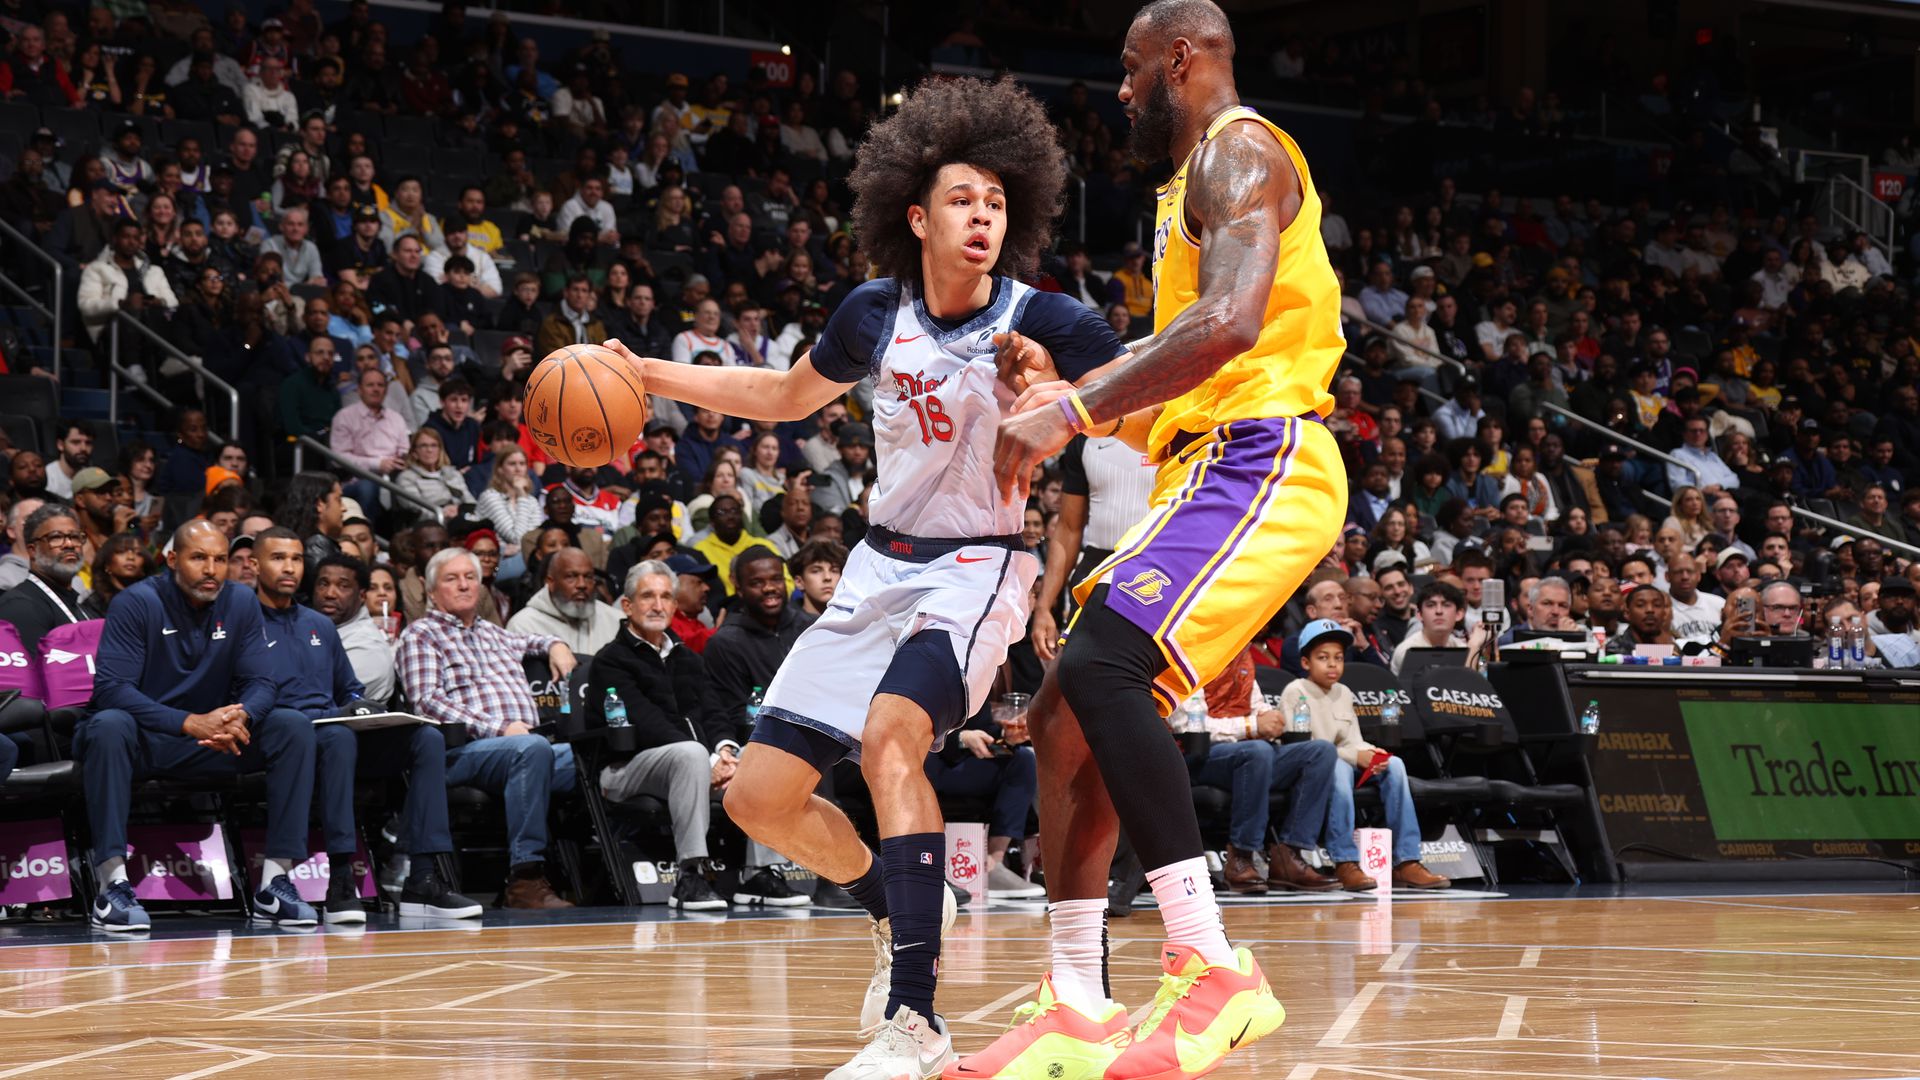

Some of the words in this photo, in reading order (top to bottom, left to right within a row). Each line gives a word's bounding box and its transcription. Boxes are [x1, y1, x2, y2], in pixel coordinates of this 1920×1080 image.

[1879, 179, 1903, 196] 120
[909, 395, 956, 447] 18
[1427, 686, 1502, 709] CAESARS
[1431, 701, 1496, 718] SPORTSBOOK
[951, 853, 970, 868] POP
[952, 865, 977, 879] CORN
